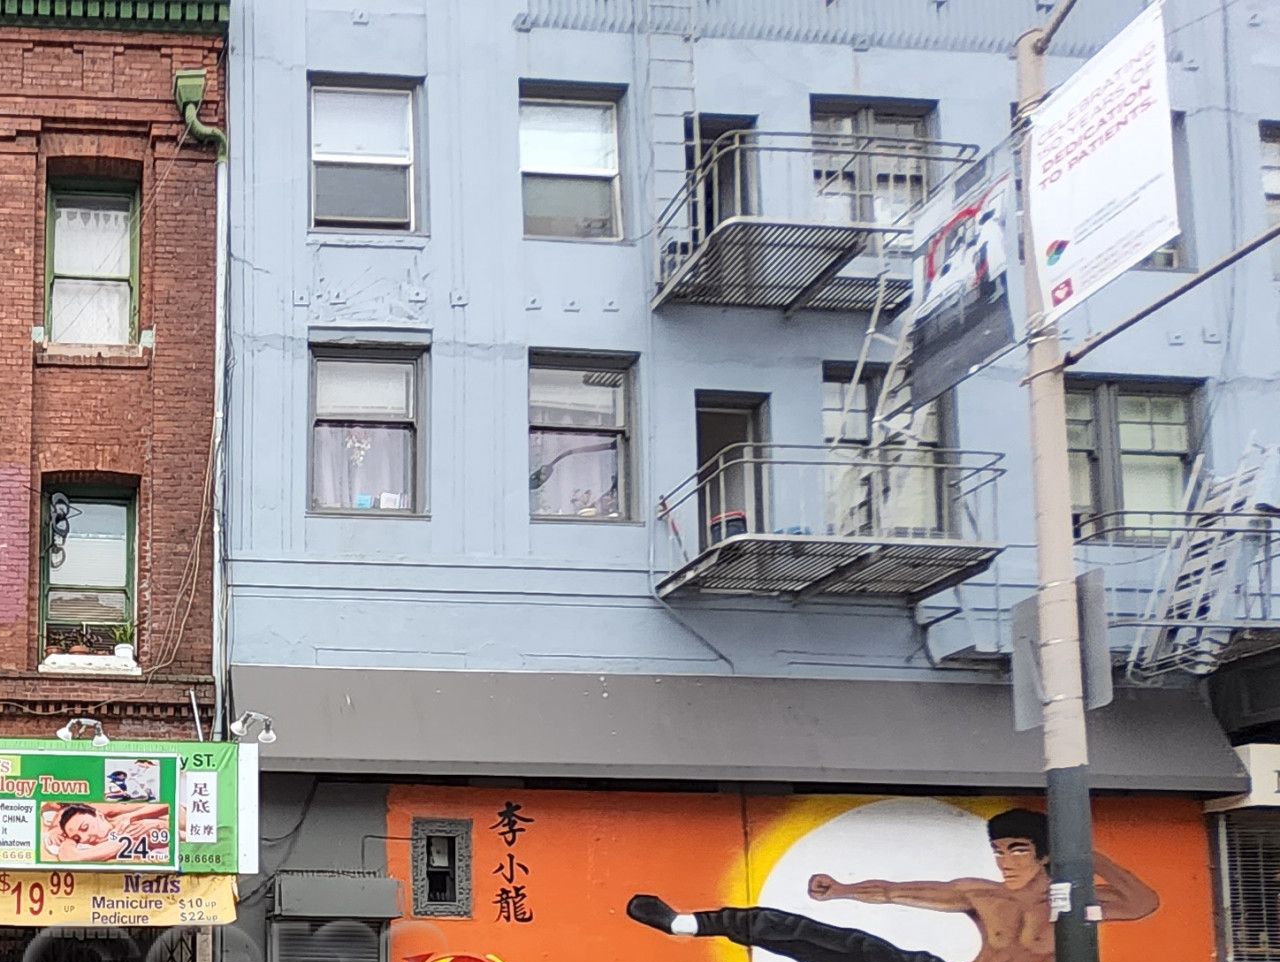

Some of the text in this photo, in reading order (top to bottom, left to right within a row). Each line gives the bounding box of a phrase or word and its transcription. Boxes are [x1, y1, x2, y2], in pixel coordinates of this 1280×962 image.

[1130, 57, 1155, 84] OF
[1042, 79, 1151, 173] DEDICATION
[1038, 169, 1063, 191] TO
[193, 754, 216, 767] ST.
[40, 776, 89, 794] Town
[192, 782, 210, 814] 足底
[190, 824, 214, 836] 按摩
[489, 800, 536, 924] 李小龍
[123, 874, 180, 894] Nails
[91, 896, 163, 909] Manicure
[91, 911, 150, 924] Pedicure
